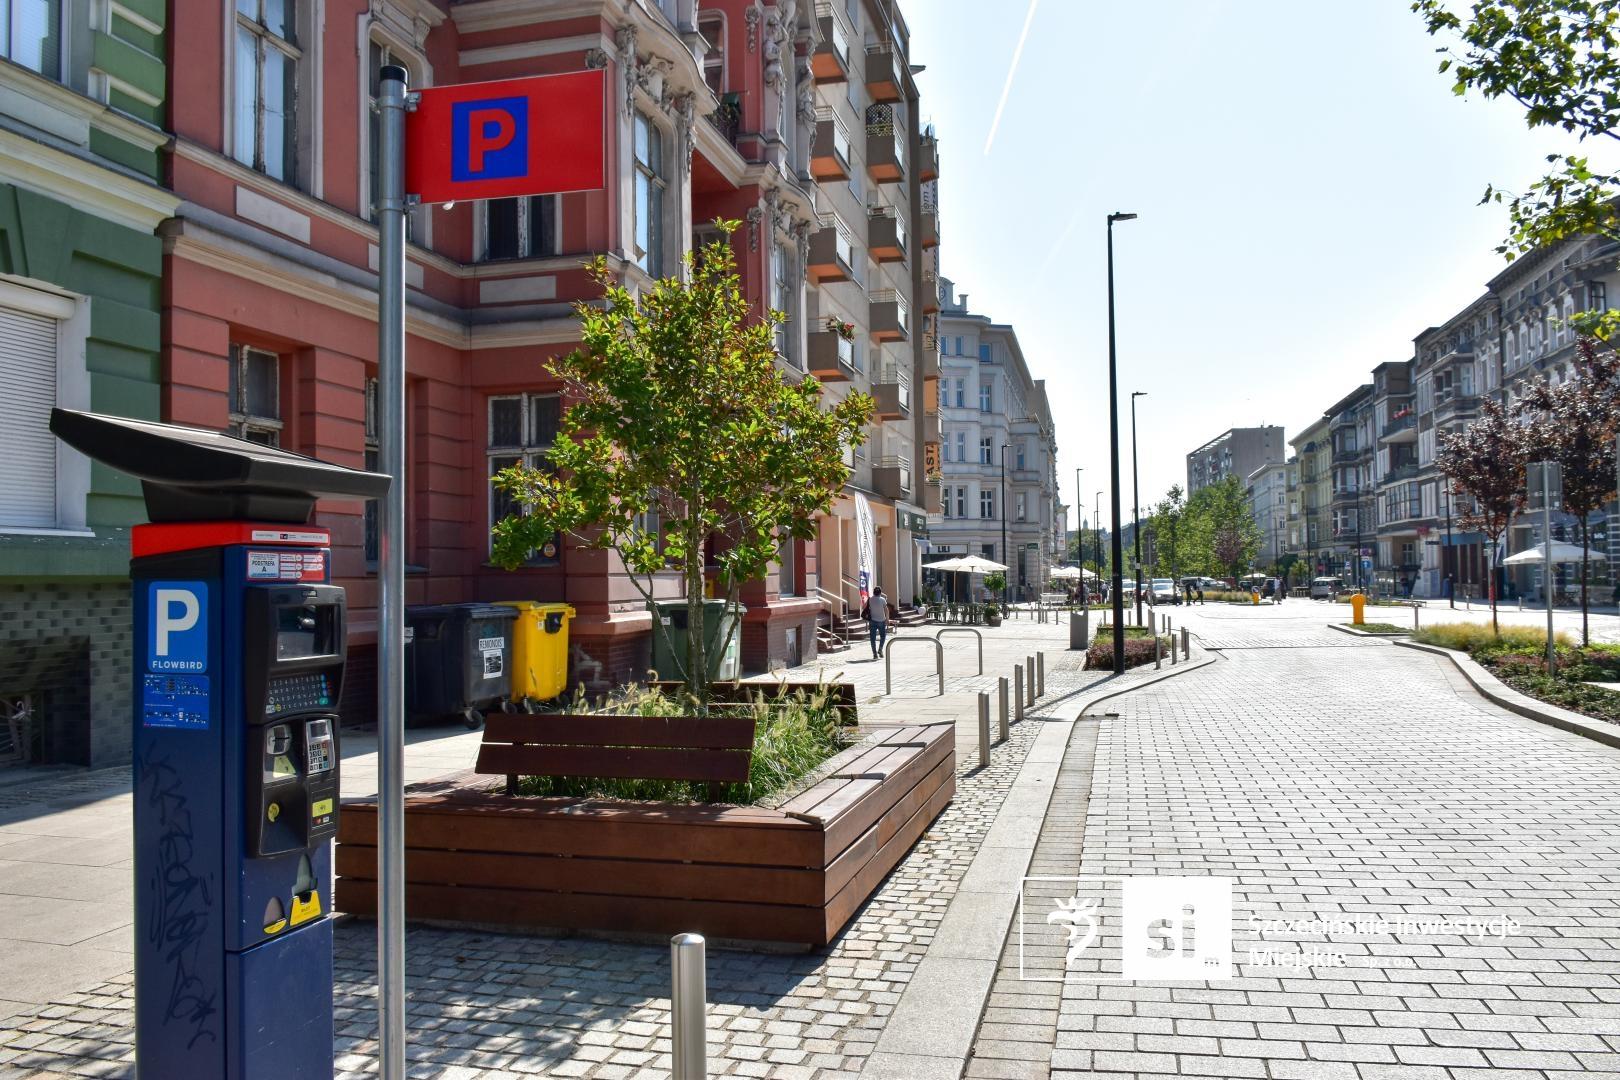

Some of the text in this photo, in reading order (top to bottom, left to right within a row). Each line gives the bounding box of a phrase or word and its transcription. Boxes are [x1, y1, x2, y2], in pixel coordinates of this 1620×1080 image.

[469, 109, 516, 172] P
[156, 589, 200, 656] P
[152, 660, 203, 670] FLOWBIRD
